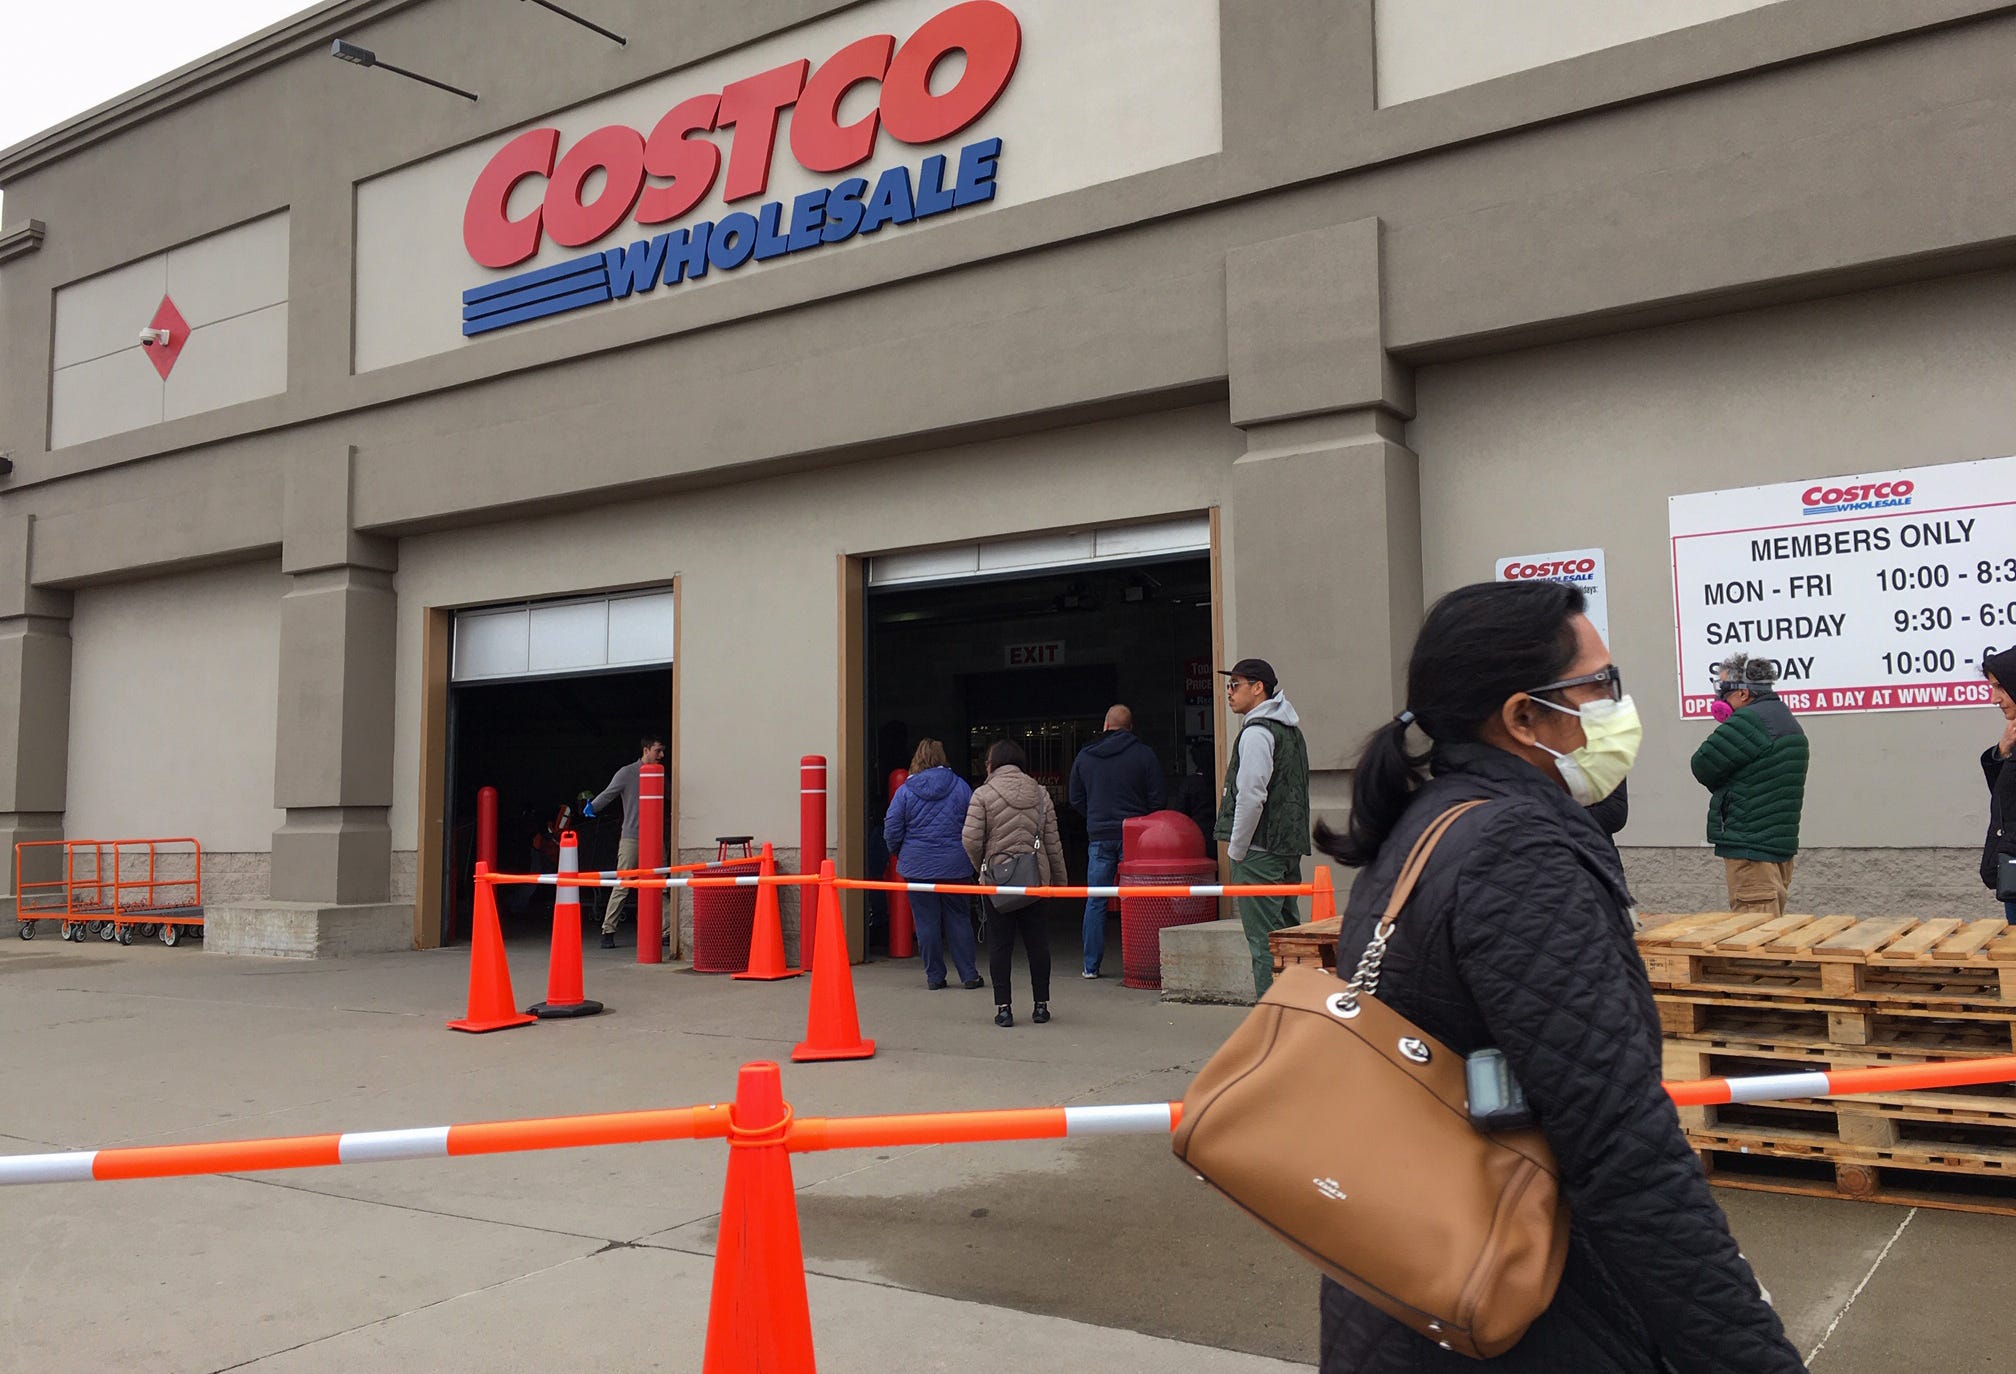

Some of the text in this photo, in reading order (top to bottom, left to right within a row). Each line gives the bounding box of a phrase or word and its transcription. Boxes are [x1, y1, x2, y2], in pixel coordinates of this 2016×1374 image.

[464, 0, 1022, 269] COSTCO
[605, 137, 1002, 300] WHOLESALE
[1802, 480, 1914, 506] COSTCO
[1836, 497, 1912, 512] WHOLESALE
[1752, 518, 1976, 562] MEMBERS ONLY
[1504, 558, 1595, 580] COSTCO
[1876, 564, 1949, 592] 10:00
[1977, 558, 2016, 584] 8:3
[1704, 579, 1764, 606] MON
[1790, 573, 1832, 598] FRI
[1706, 614, 1847, 645] SATURDAY
[1894, 606, 1952, 633] 9:30
[1980, 601, 2016, 627] 6:0
[1010, 644, 1058, 665] EXIT
[1882, 648, 1955, 675] 10:00
[1709, 656, 1815, 684] SDAY
[1685, 698, 1715, 714] OPE
[1815, 692, 1828, 708] A
[1832, 690, 1865, 707] DAY
[1871, 689, 1893, 705] AT
[1897, 684, 1994, 704] WWW.COS
